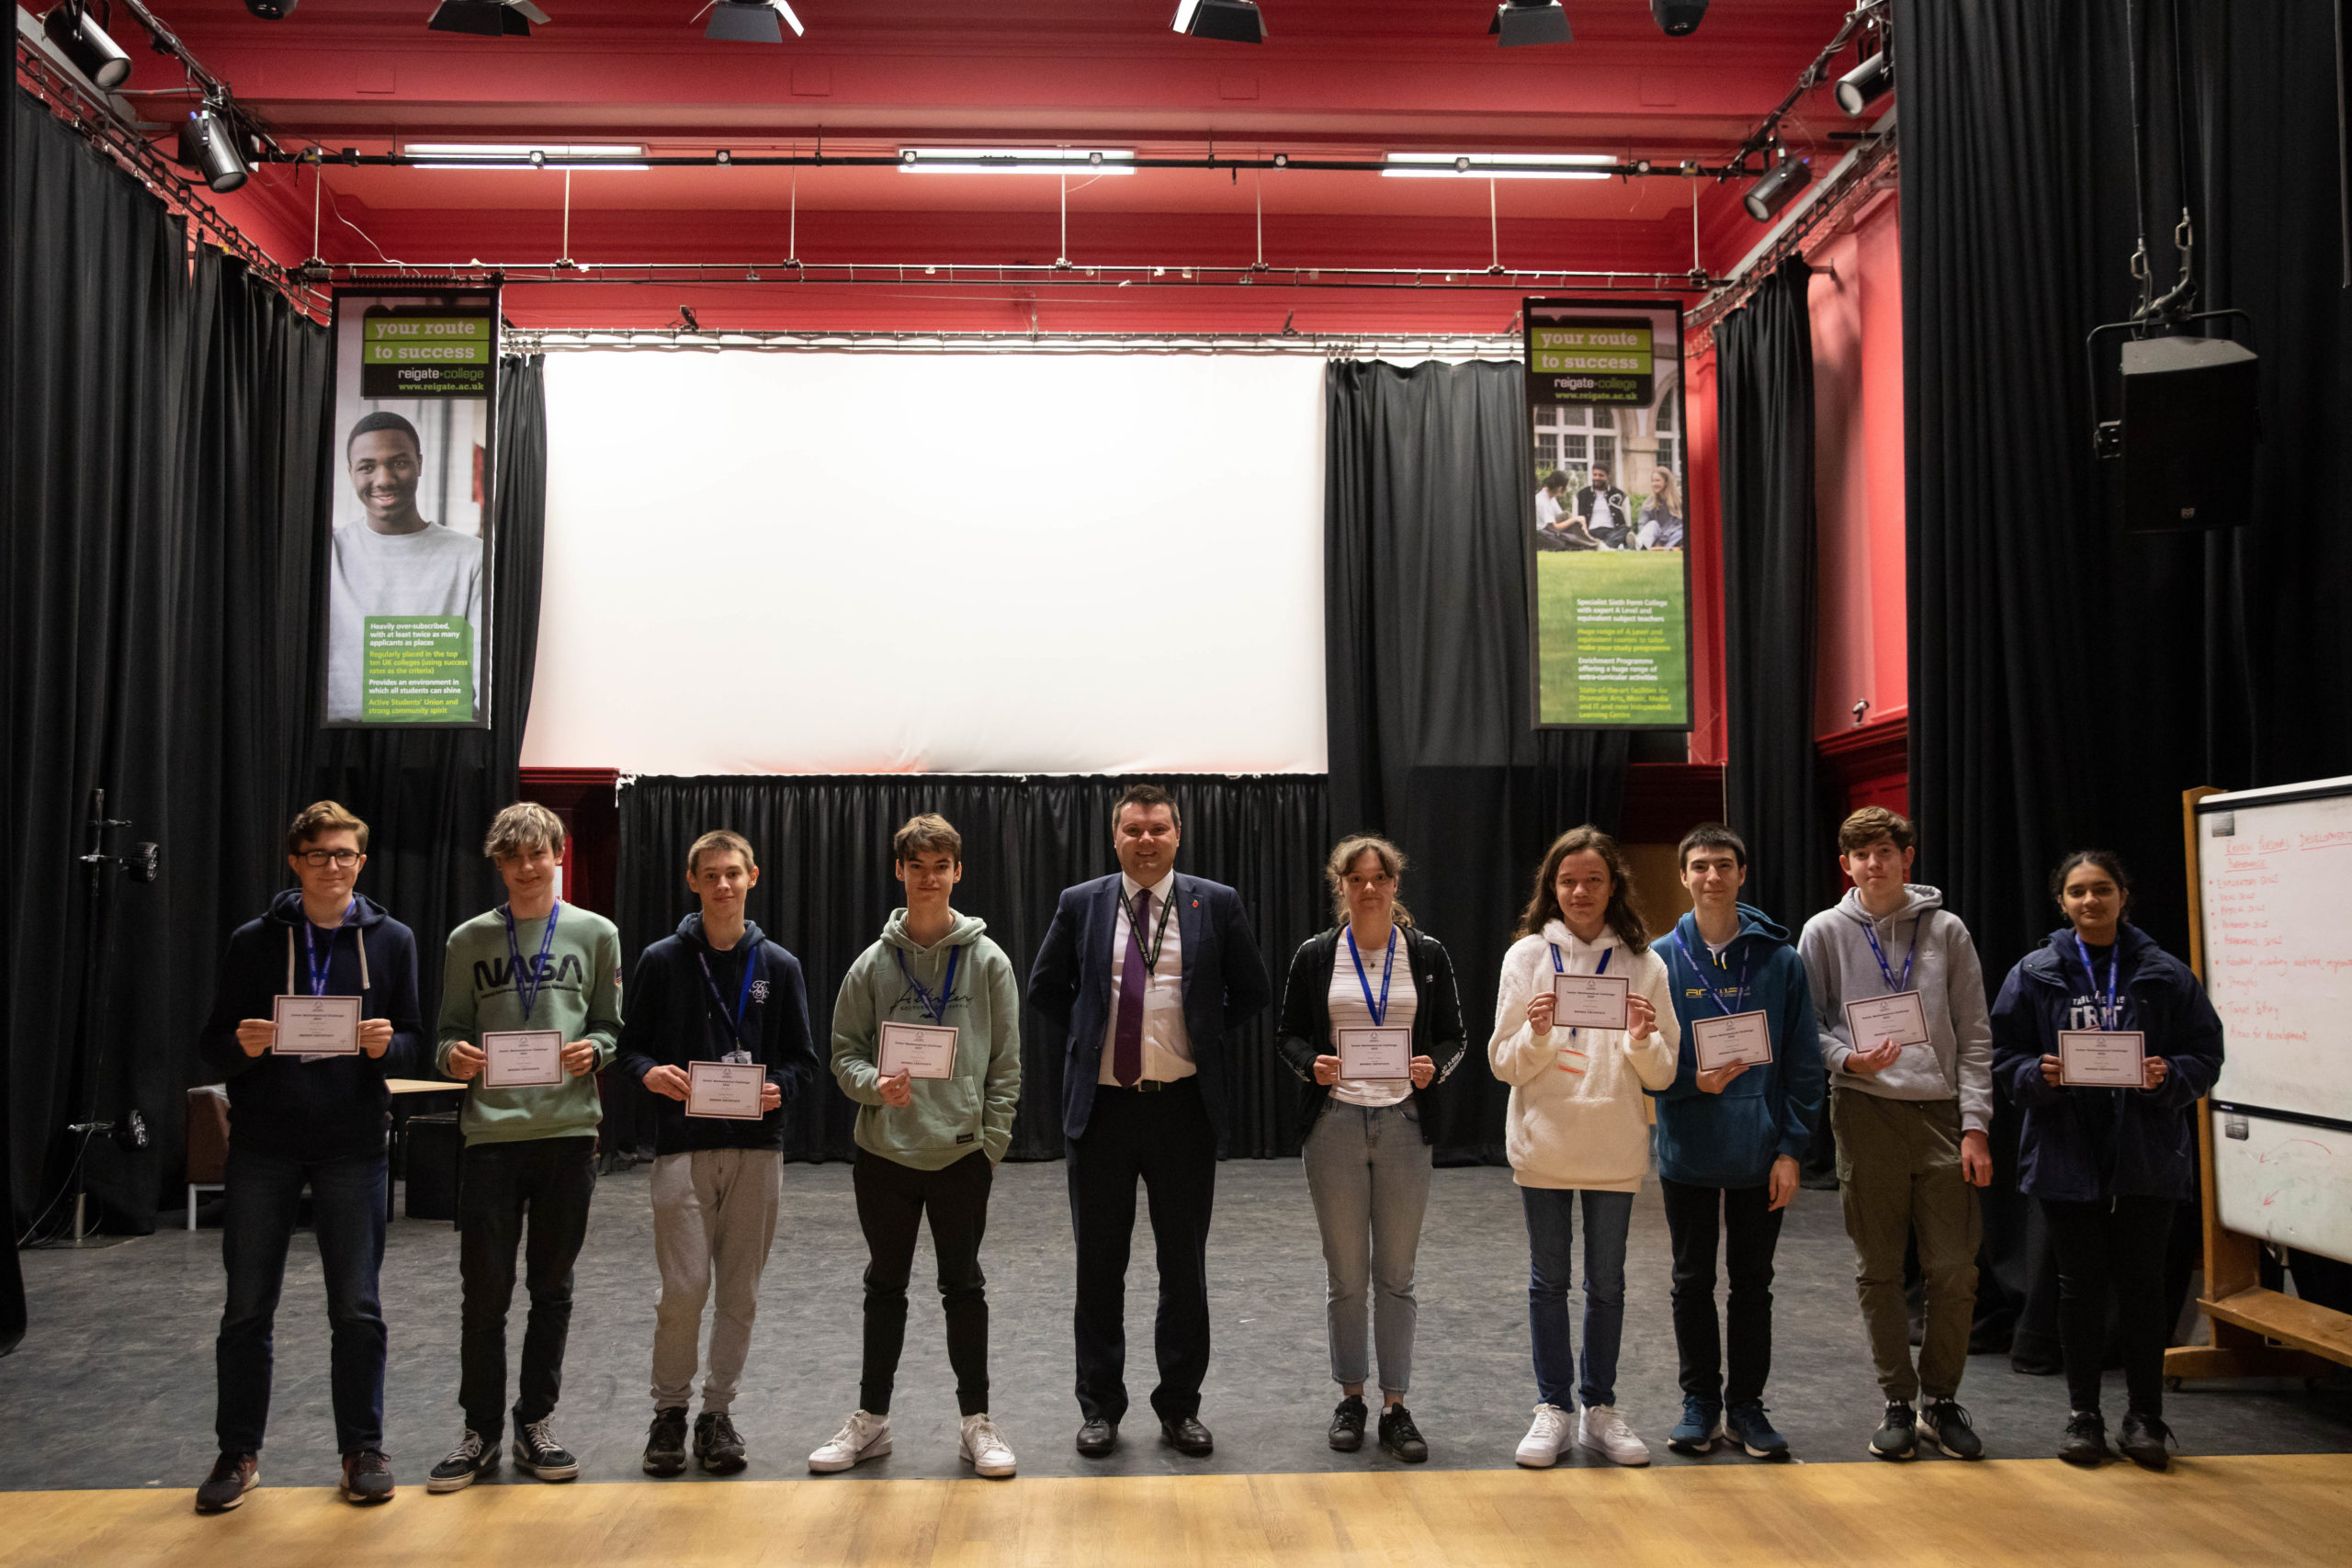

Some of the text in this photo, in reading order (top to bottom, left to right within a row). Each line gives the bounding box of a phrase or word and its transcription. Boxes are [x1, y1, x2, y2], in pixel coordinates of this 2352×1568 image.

[376, 321, 475, 338] your route
[1541, 333, 1637, 348] your route
[376, 344, 475, 359] to success
[1542, 355, 1638, 369] to success
[399, 383, 484, 392] www.reigate.ac.uk
[473, 953, 582, 990] NASA
